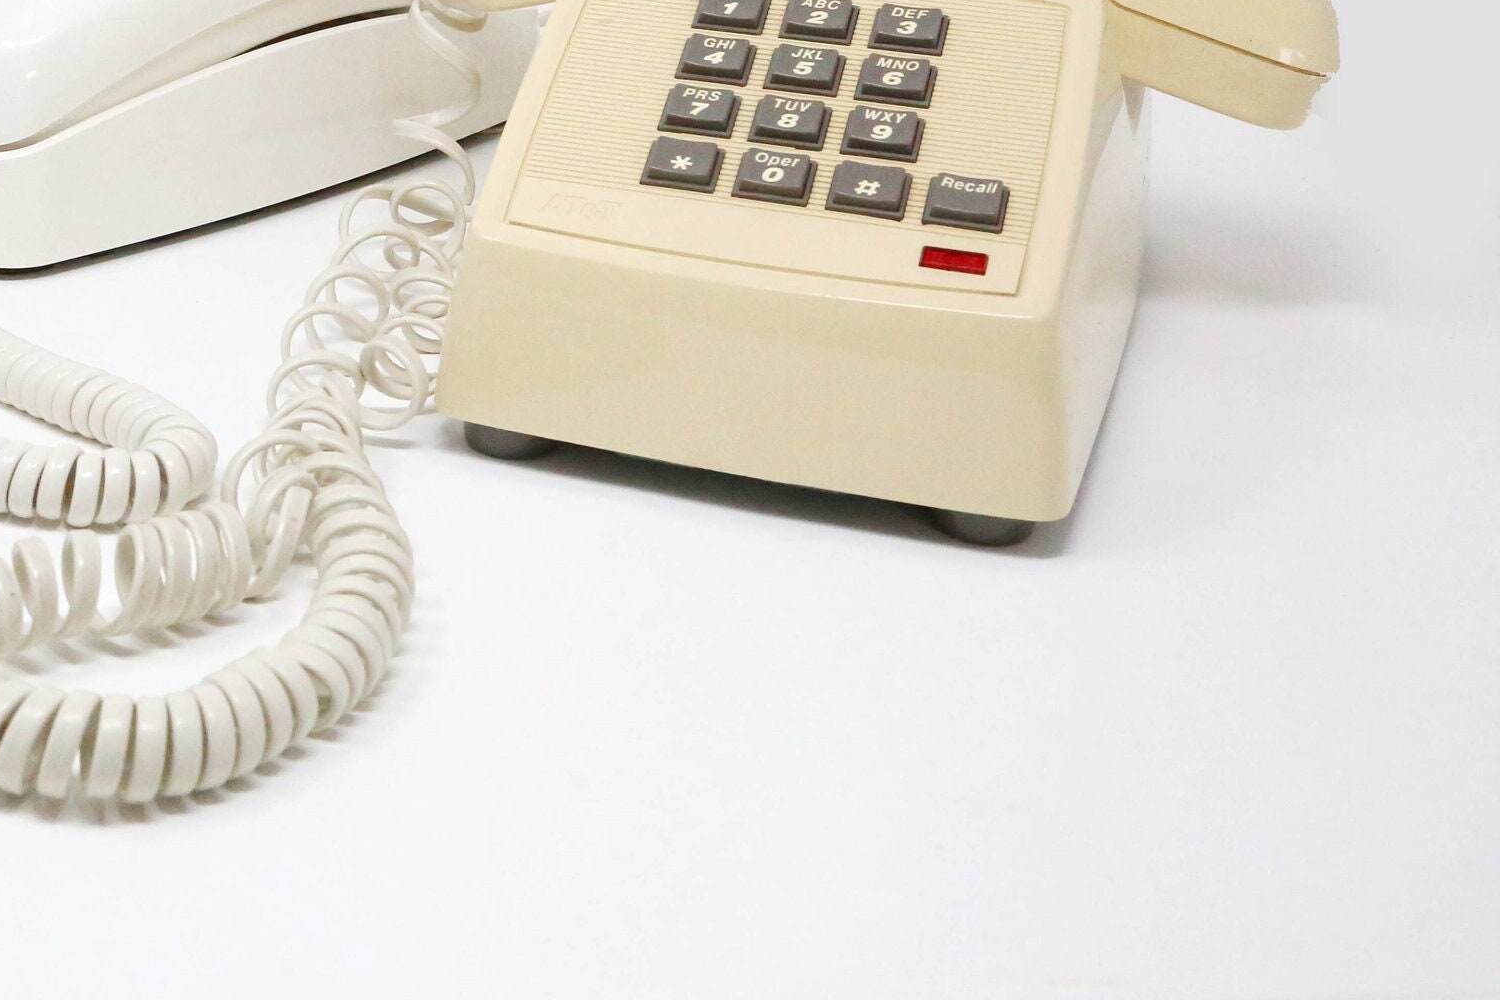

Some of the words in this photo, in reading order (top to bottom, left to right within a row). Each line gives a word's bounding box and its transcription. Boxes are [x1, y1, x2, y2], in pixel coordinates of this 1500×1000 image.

[722, 1, 739, 16] 1
[891, 6, 930, 20] DEF
[805, 11, 829, 26] 2
[895, 20, 918, 36] 3
[703, 36, 737, 51] GHI
[703, 50, 726, 65] 4
[790, 47, 825, 61] JKL
[791, 61, 815, 76] 5
[876, 57, 921, 72] MNO
[881, 71, 904, 87] 6
[682, 87, 723, 102] PRS
[687, 101, 711, 117] 7
[774, 97, 813, 113] TUV
[775, 113, 800, 129] 8
[864, 109, 908, 125] WXY
[869, 124, 893, 140] 9
[754, 151, 801, 168] Oper
[760, 167, 784, 183] 0
[853, 179, 881, 197] #
[940, 175, 1000, 195] Recall
